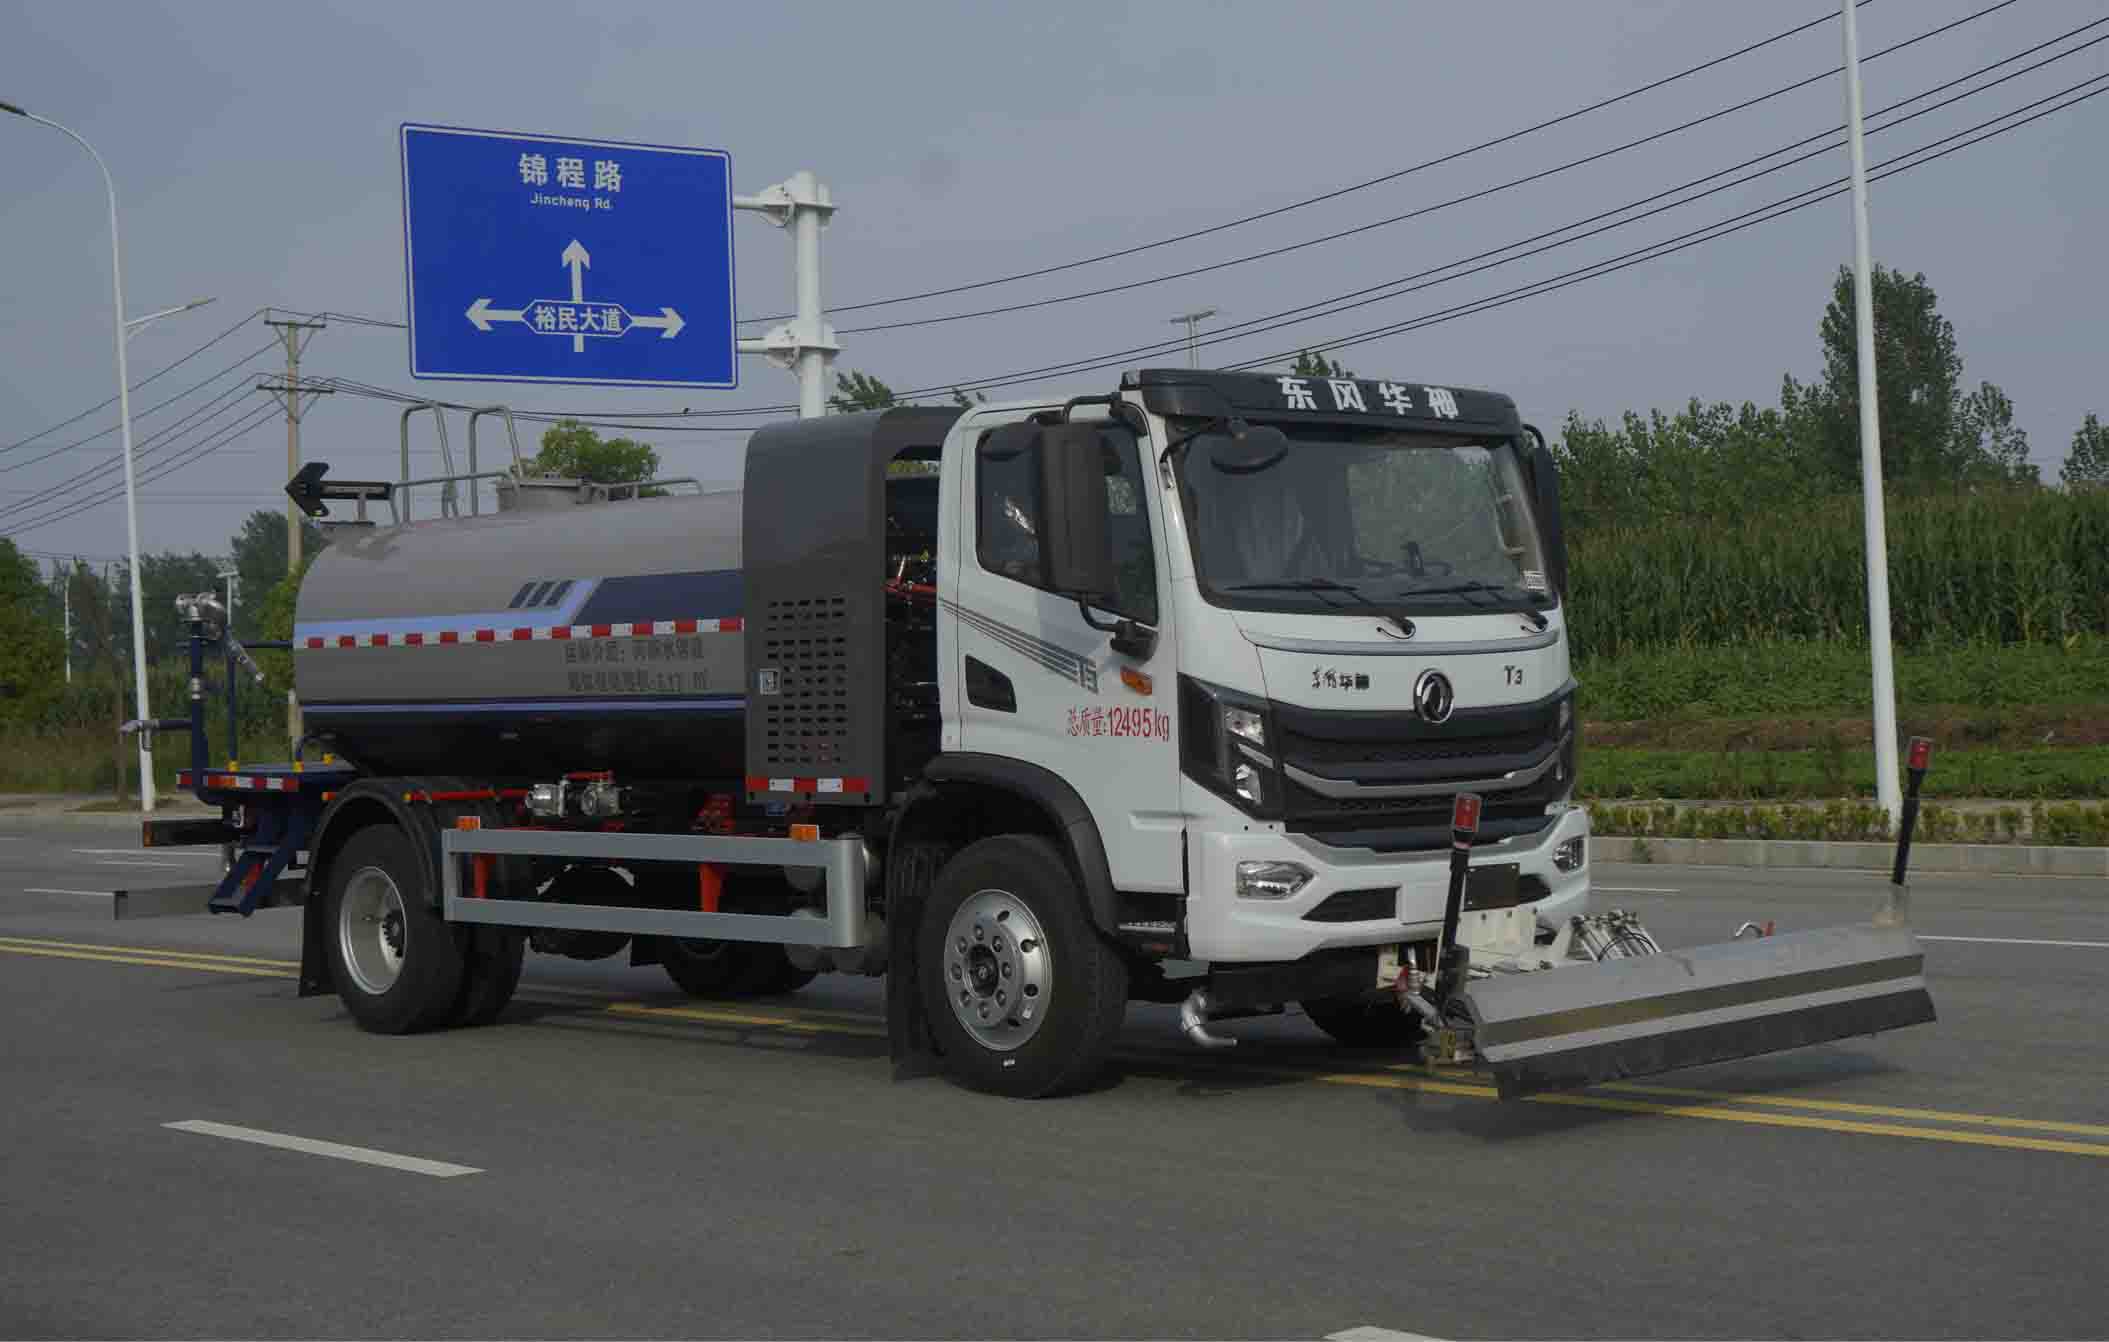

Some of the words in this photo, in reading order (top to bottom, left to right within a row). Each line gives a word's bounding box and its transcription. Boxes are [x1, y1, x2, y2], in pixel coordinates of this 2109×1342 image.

[518, 152, 622, 193] 锦程路
[530, 192, 591, 212] Jincheng
[533, 304, 624, 334] 裕民大道
[1276, 376, 1460, 420] 东风华神
[1504, 664, 1524, 686] T3
